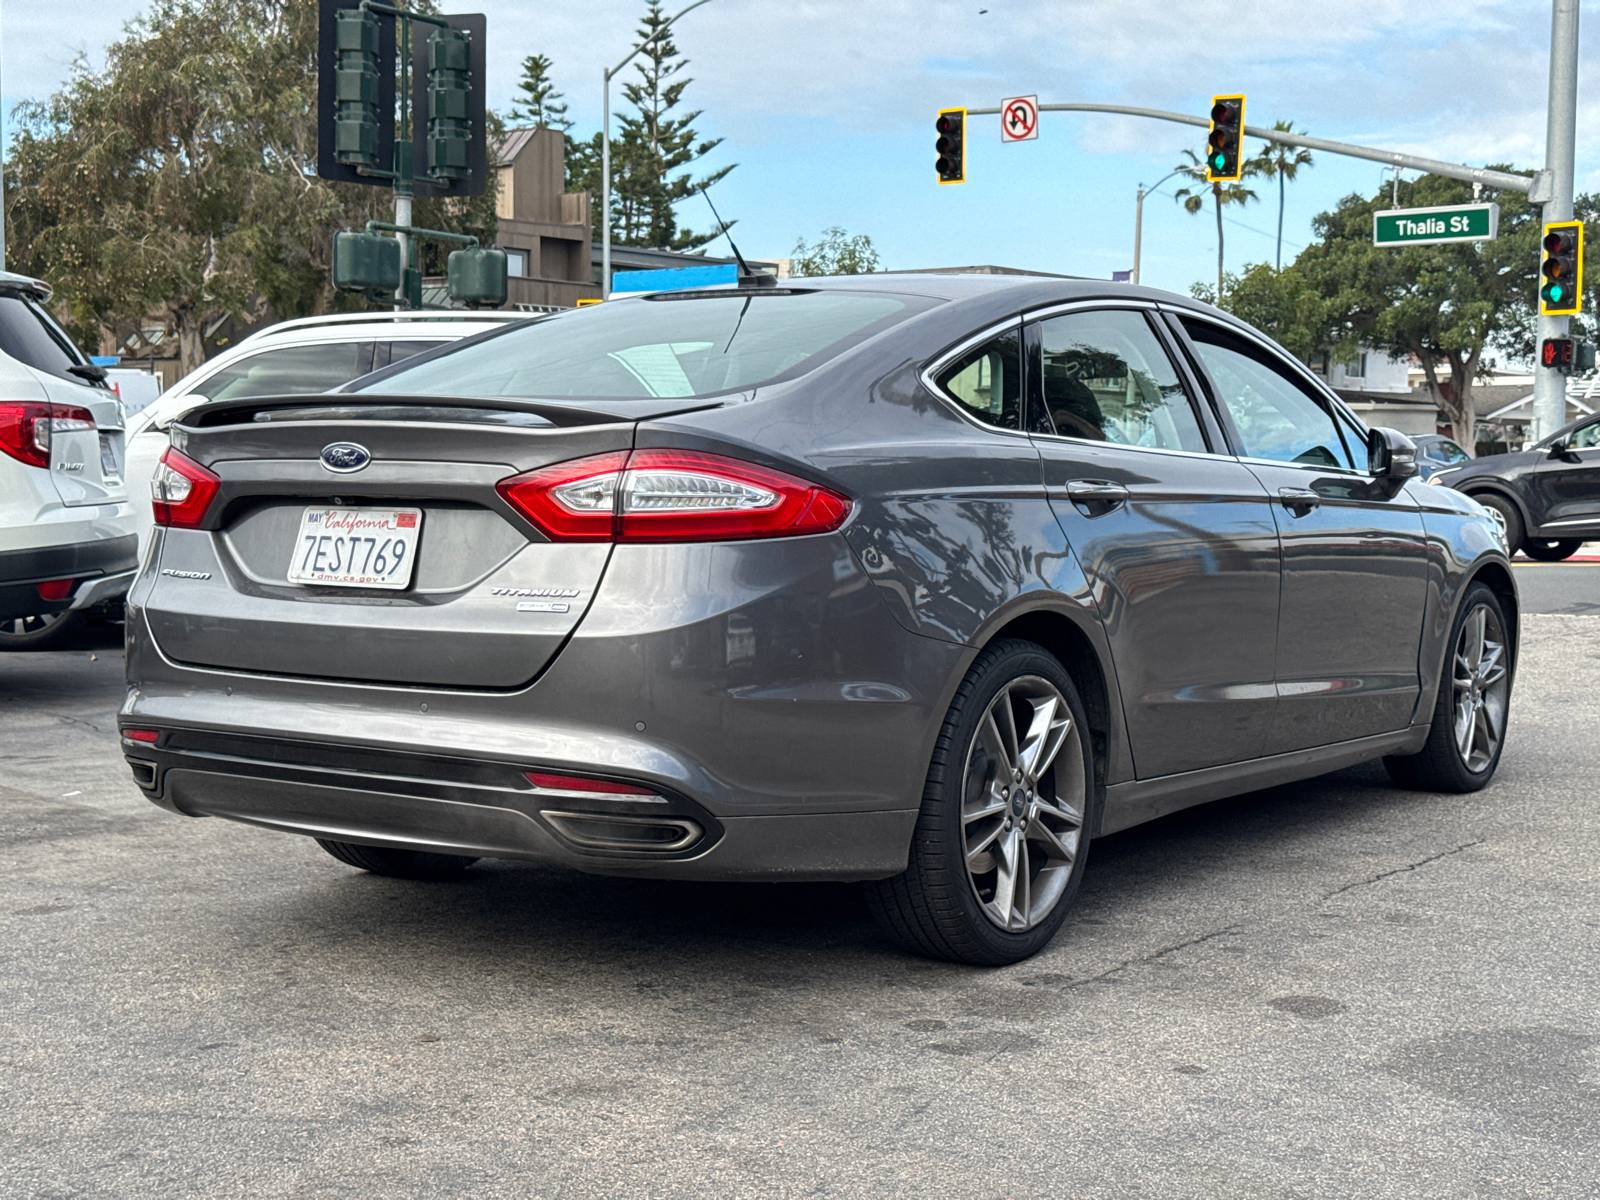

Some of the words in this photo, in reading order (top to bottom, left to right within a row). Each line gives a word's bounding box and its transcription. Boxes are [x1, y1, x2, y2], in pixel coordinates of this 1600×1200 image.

[1396, 217, 1445, 236] Thalia
[1450, 216, 1469, 232] St
[330, 448, 358, 465] Ford
[308, 512, 323, 523] MAY
[325, 511, 396, 534] California
[302, 535, 406, 575] 7EST769
[162, 568, 212, 580] FUSION
[317, 574, 378, 583] dmv.ca.gov
[492, 587, 580, 597] TITANIUM
